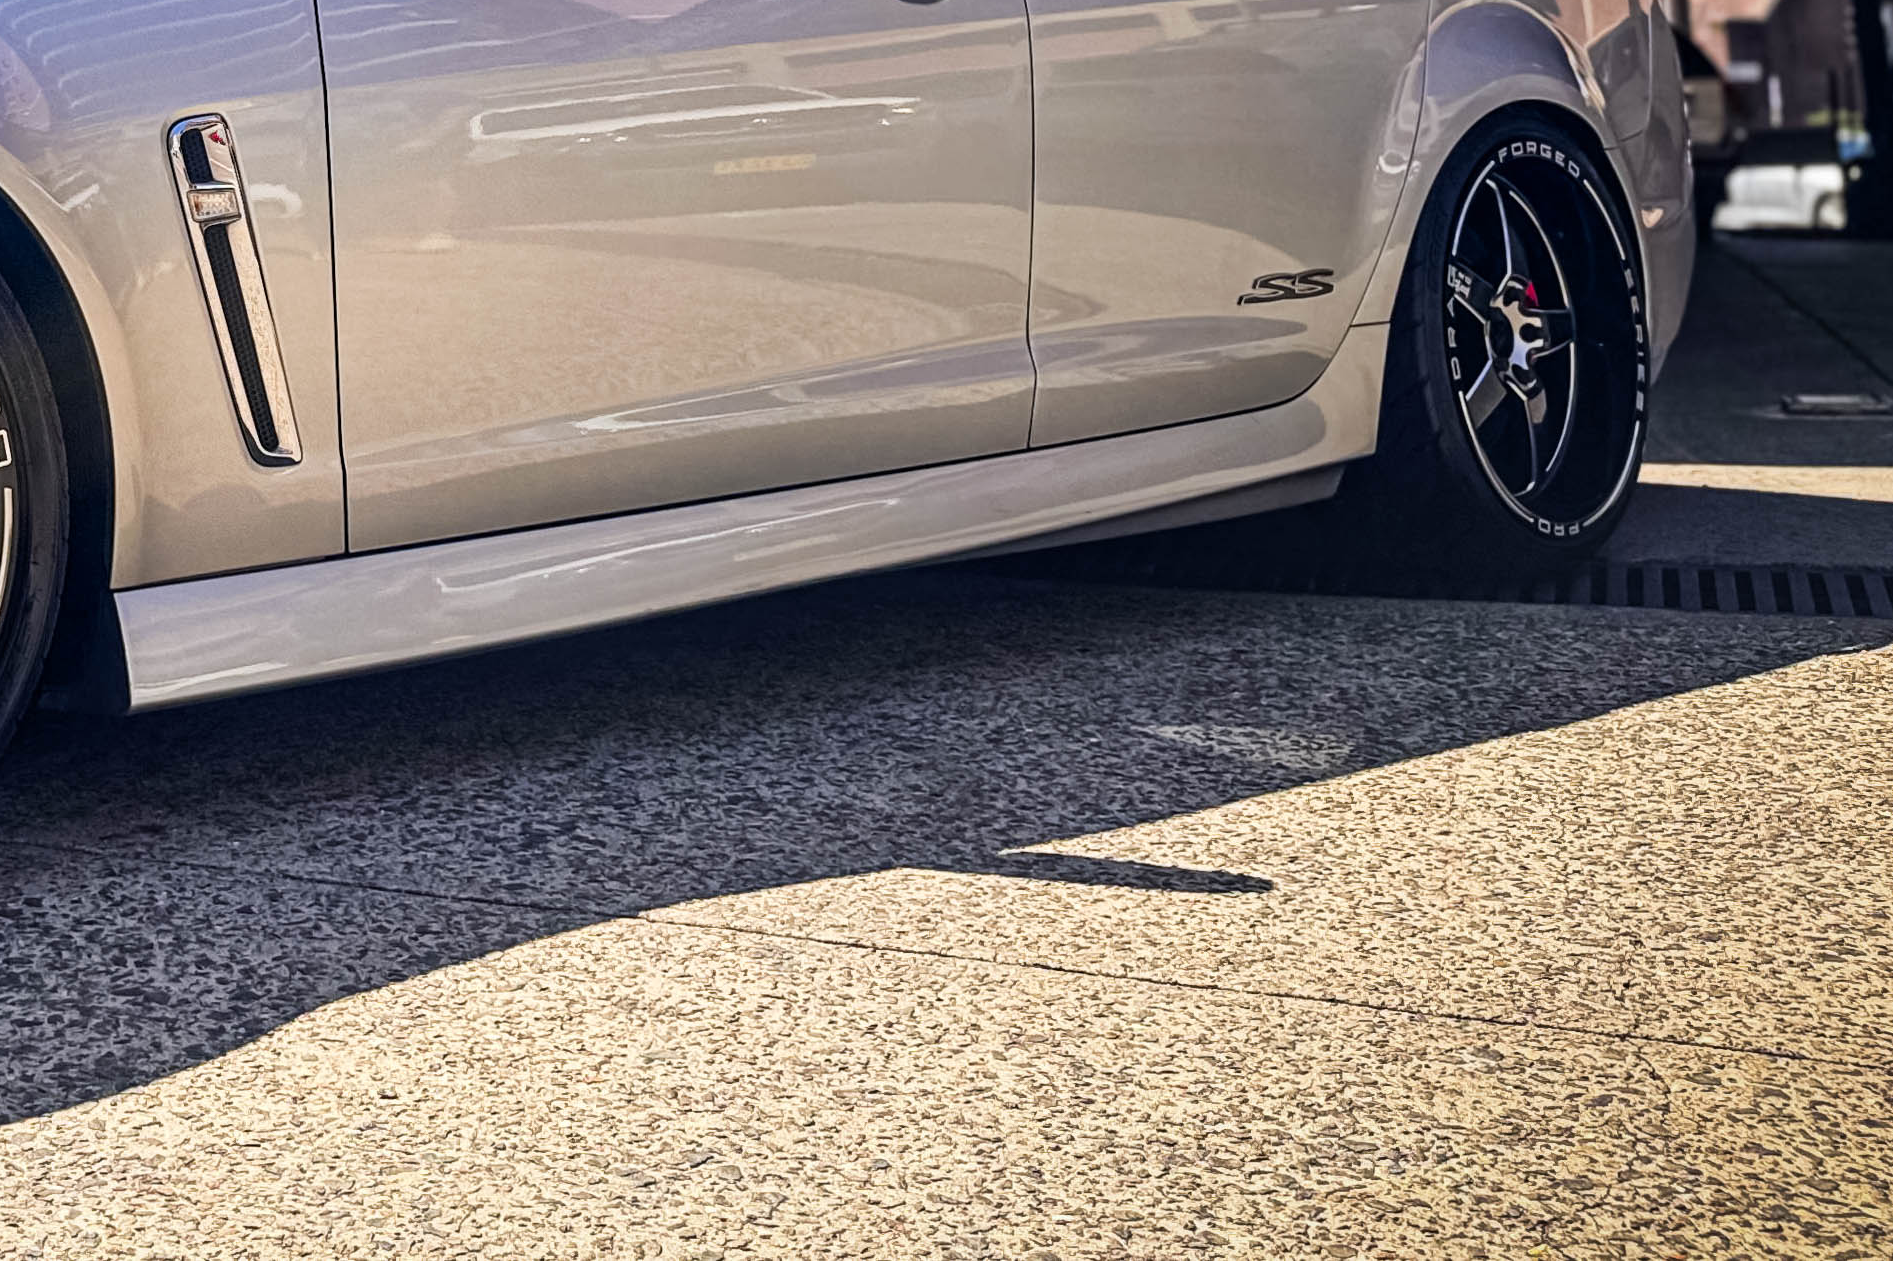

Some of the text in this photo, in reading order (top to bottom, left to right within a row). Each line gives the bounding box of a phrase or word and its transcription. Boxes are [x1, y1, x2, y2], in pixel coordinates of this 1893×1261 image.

[1498, 141, 1580, 179] FORGED
[1236, 268, 1334, 306] SS
[1538, 518, 1580, 537] PRO
